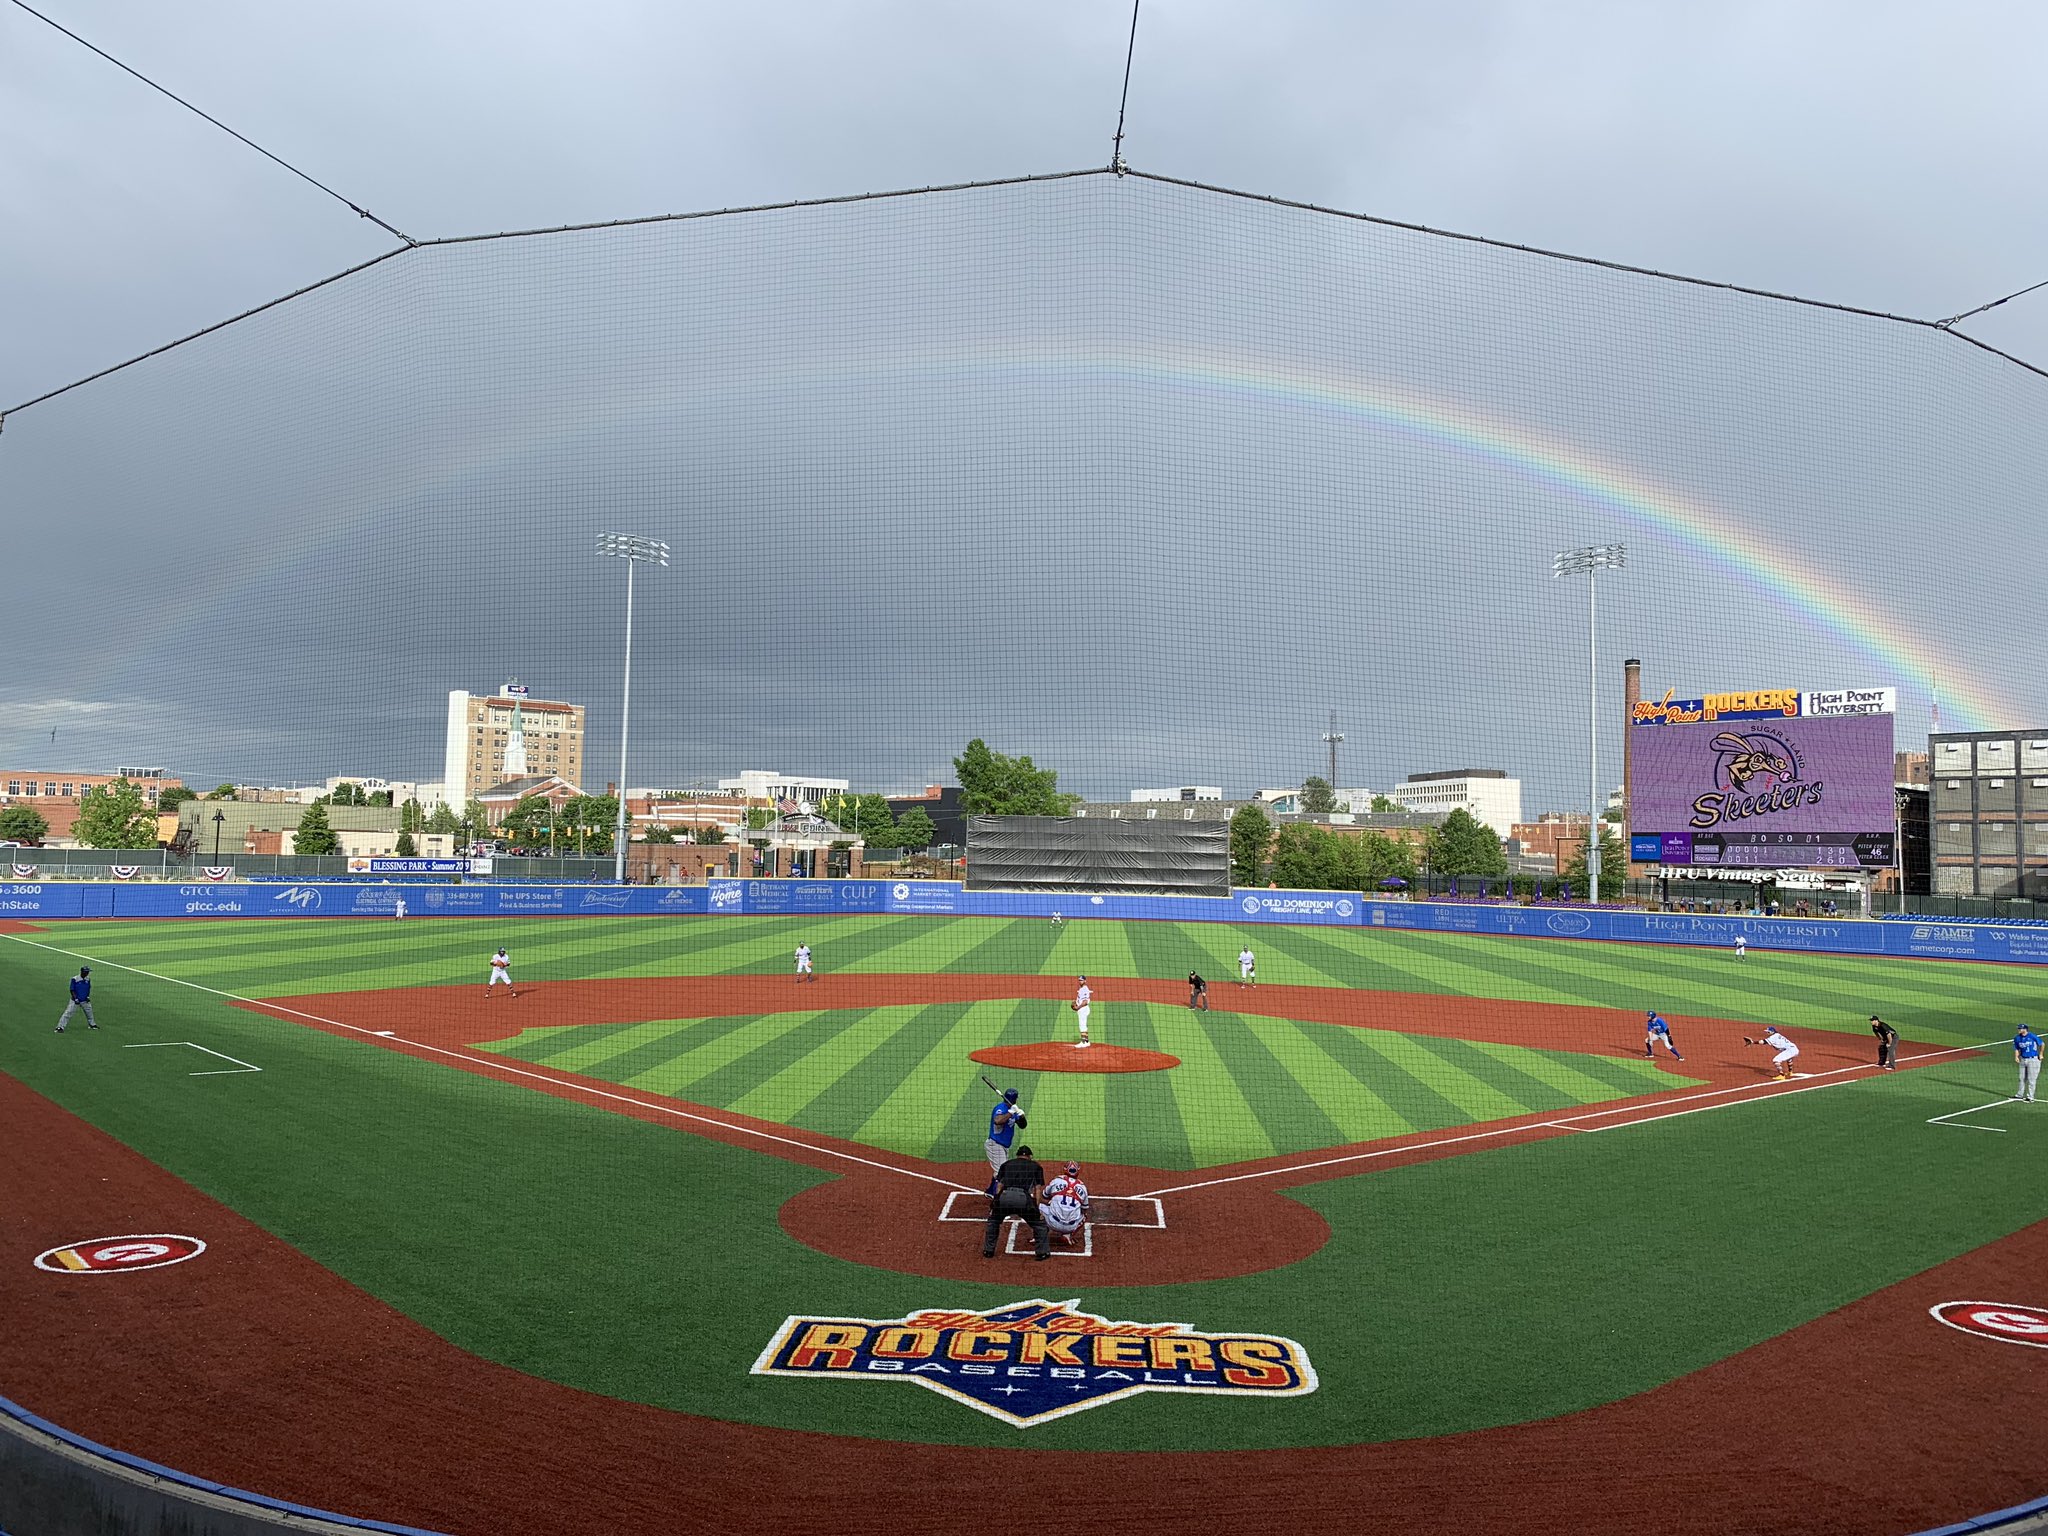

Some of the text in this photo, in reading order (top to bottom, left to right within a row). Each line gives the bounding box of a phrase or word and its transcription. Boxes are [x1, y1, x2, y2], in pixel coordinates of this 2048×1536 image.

[1809, 690, 1885, 704] HIGH POINT
[1634, 692, 1702, 722] High Point
[1703, 689, 1798, 720] ROCKERS
[1809, 702, 1885, 715] UNIVERSITY
[1750, 725, 1784, 738] SUGAR
[1790, 742, 1806, 769] LAND
[1688, 780, 1824, 829] Skeeters
[1778, 834, 1784, 842] S
[372, 861, 407, 870] BLESSING
[408, 861, 427, 870] PARK
[431, 861, 455, 871] Summer
[456, 862, 469, 870] 209
[1658, 868, 1825, 884] HPU Vintage Seats
[12, 885, 41, 894] 3600
[180, 886, 214, 896] GTCC
[710, 889, 742, 903] Home
[842, 885, 876, 899] CULP
[586, 893, 628, 902] Budweiser
[1262, 899, 1281, 907] OLD
[1284, 900, 1333, 909] DOMINION
[186, 901, 241, 913] gtcc.edu
[1495, 915, 1526, 924] ULTRA
[1645, 917, 1841, 937] HIGH POINT UNIVERSITY
[1934, 927, 1974, 938] SAMET
[1760, 935, 1811, 946] University
[1910, 945, 1975, 954] sametcorp.com
[1060, 1195, 1076, 1207] 11
[906, 1305, 1184, 1337] High Point
[789, 1323, 1292, 1386] ROCKERS
[867, 1360, 1217, 1385] BASEBALL
